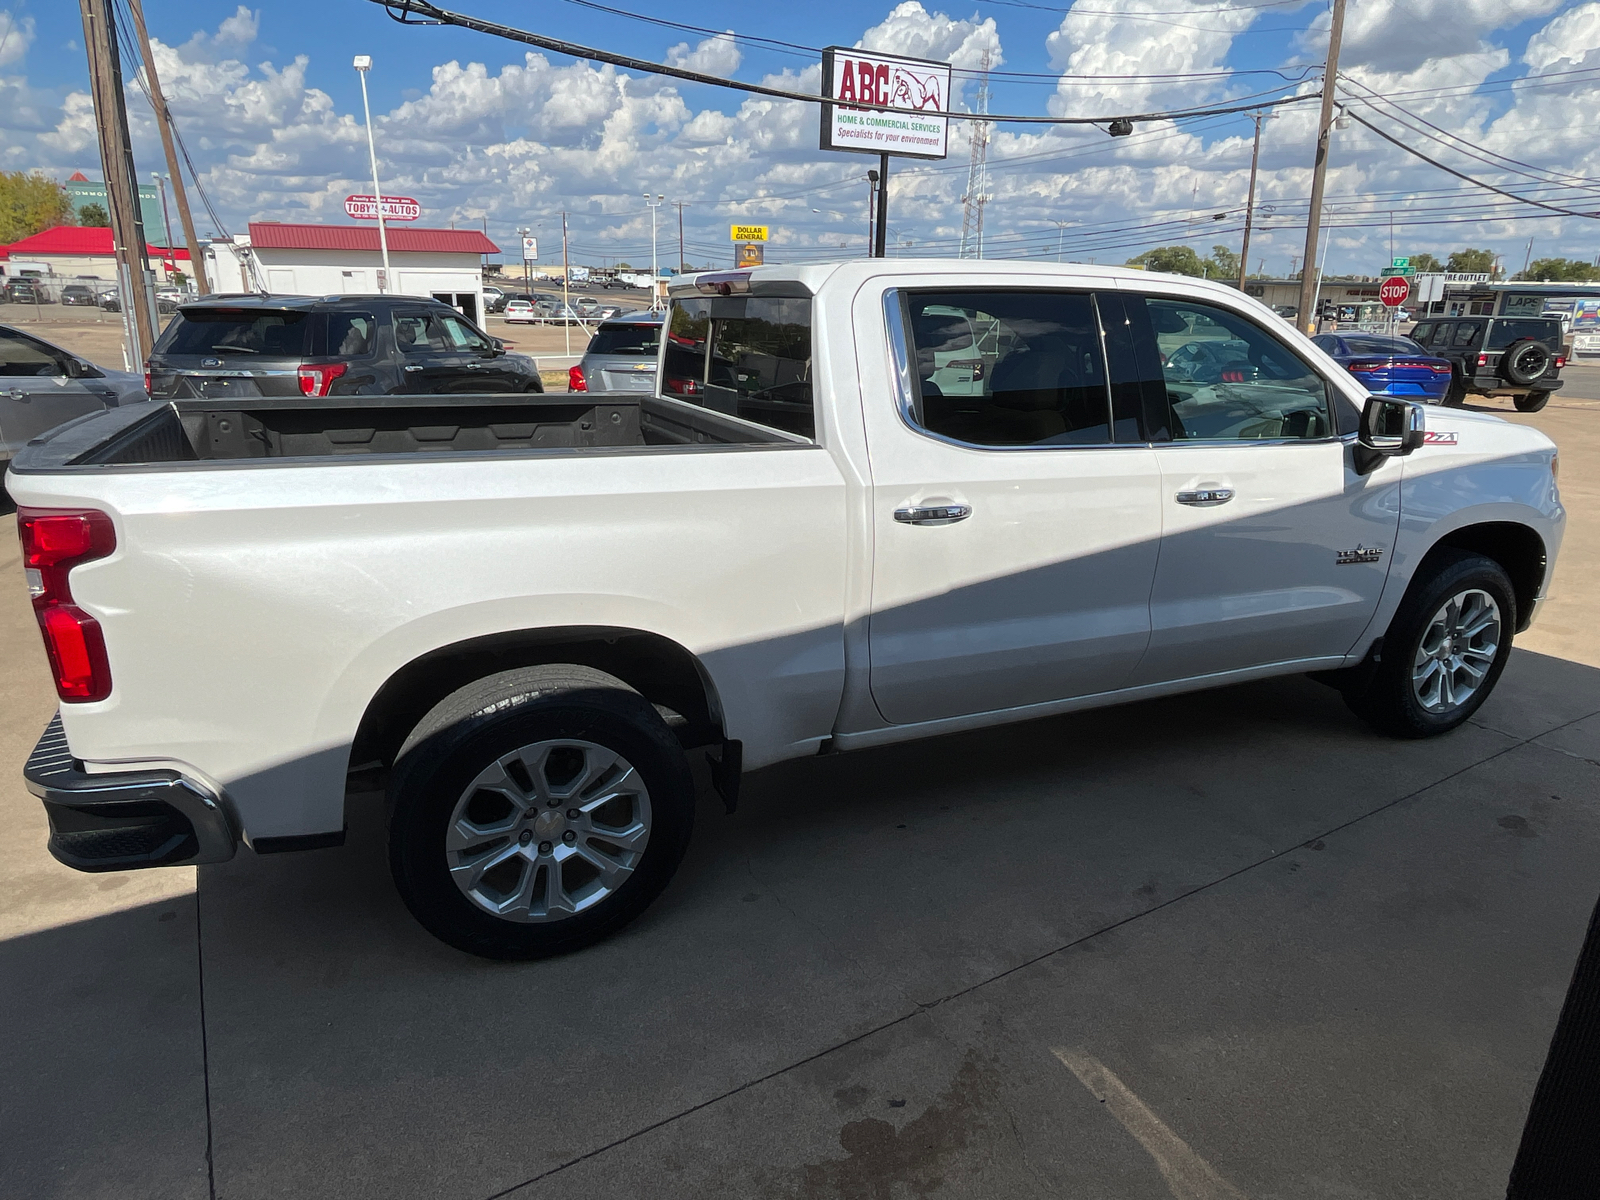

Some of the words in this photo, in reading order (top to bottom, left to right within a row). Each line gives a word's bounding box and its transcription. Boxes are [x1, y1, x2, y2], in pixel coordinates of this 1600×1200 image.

[838, 59, 890, 113] ABC
[837, 114, 858, 125] HOME
[859, 116, 865, 125] &
[866, 117, 910, 131] COMMERCIAL
[911, 122, 941, 134] SERVICES
[837, 127, 873, 140] Specialists
[874, 130, 884, 140] for
[885, 133, 900, 143] your
[900, 134, 940, 146] environment
[388, 204, 418, 215] AUTOS
[1382, 286, 1407, 298] STOP
[1507, 297, 1539, 307] LAPS
